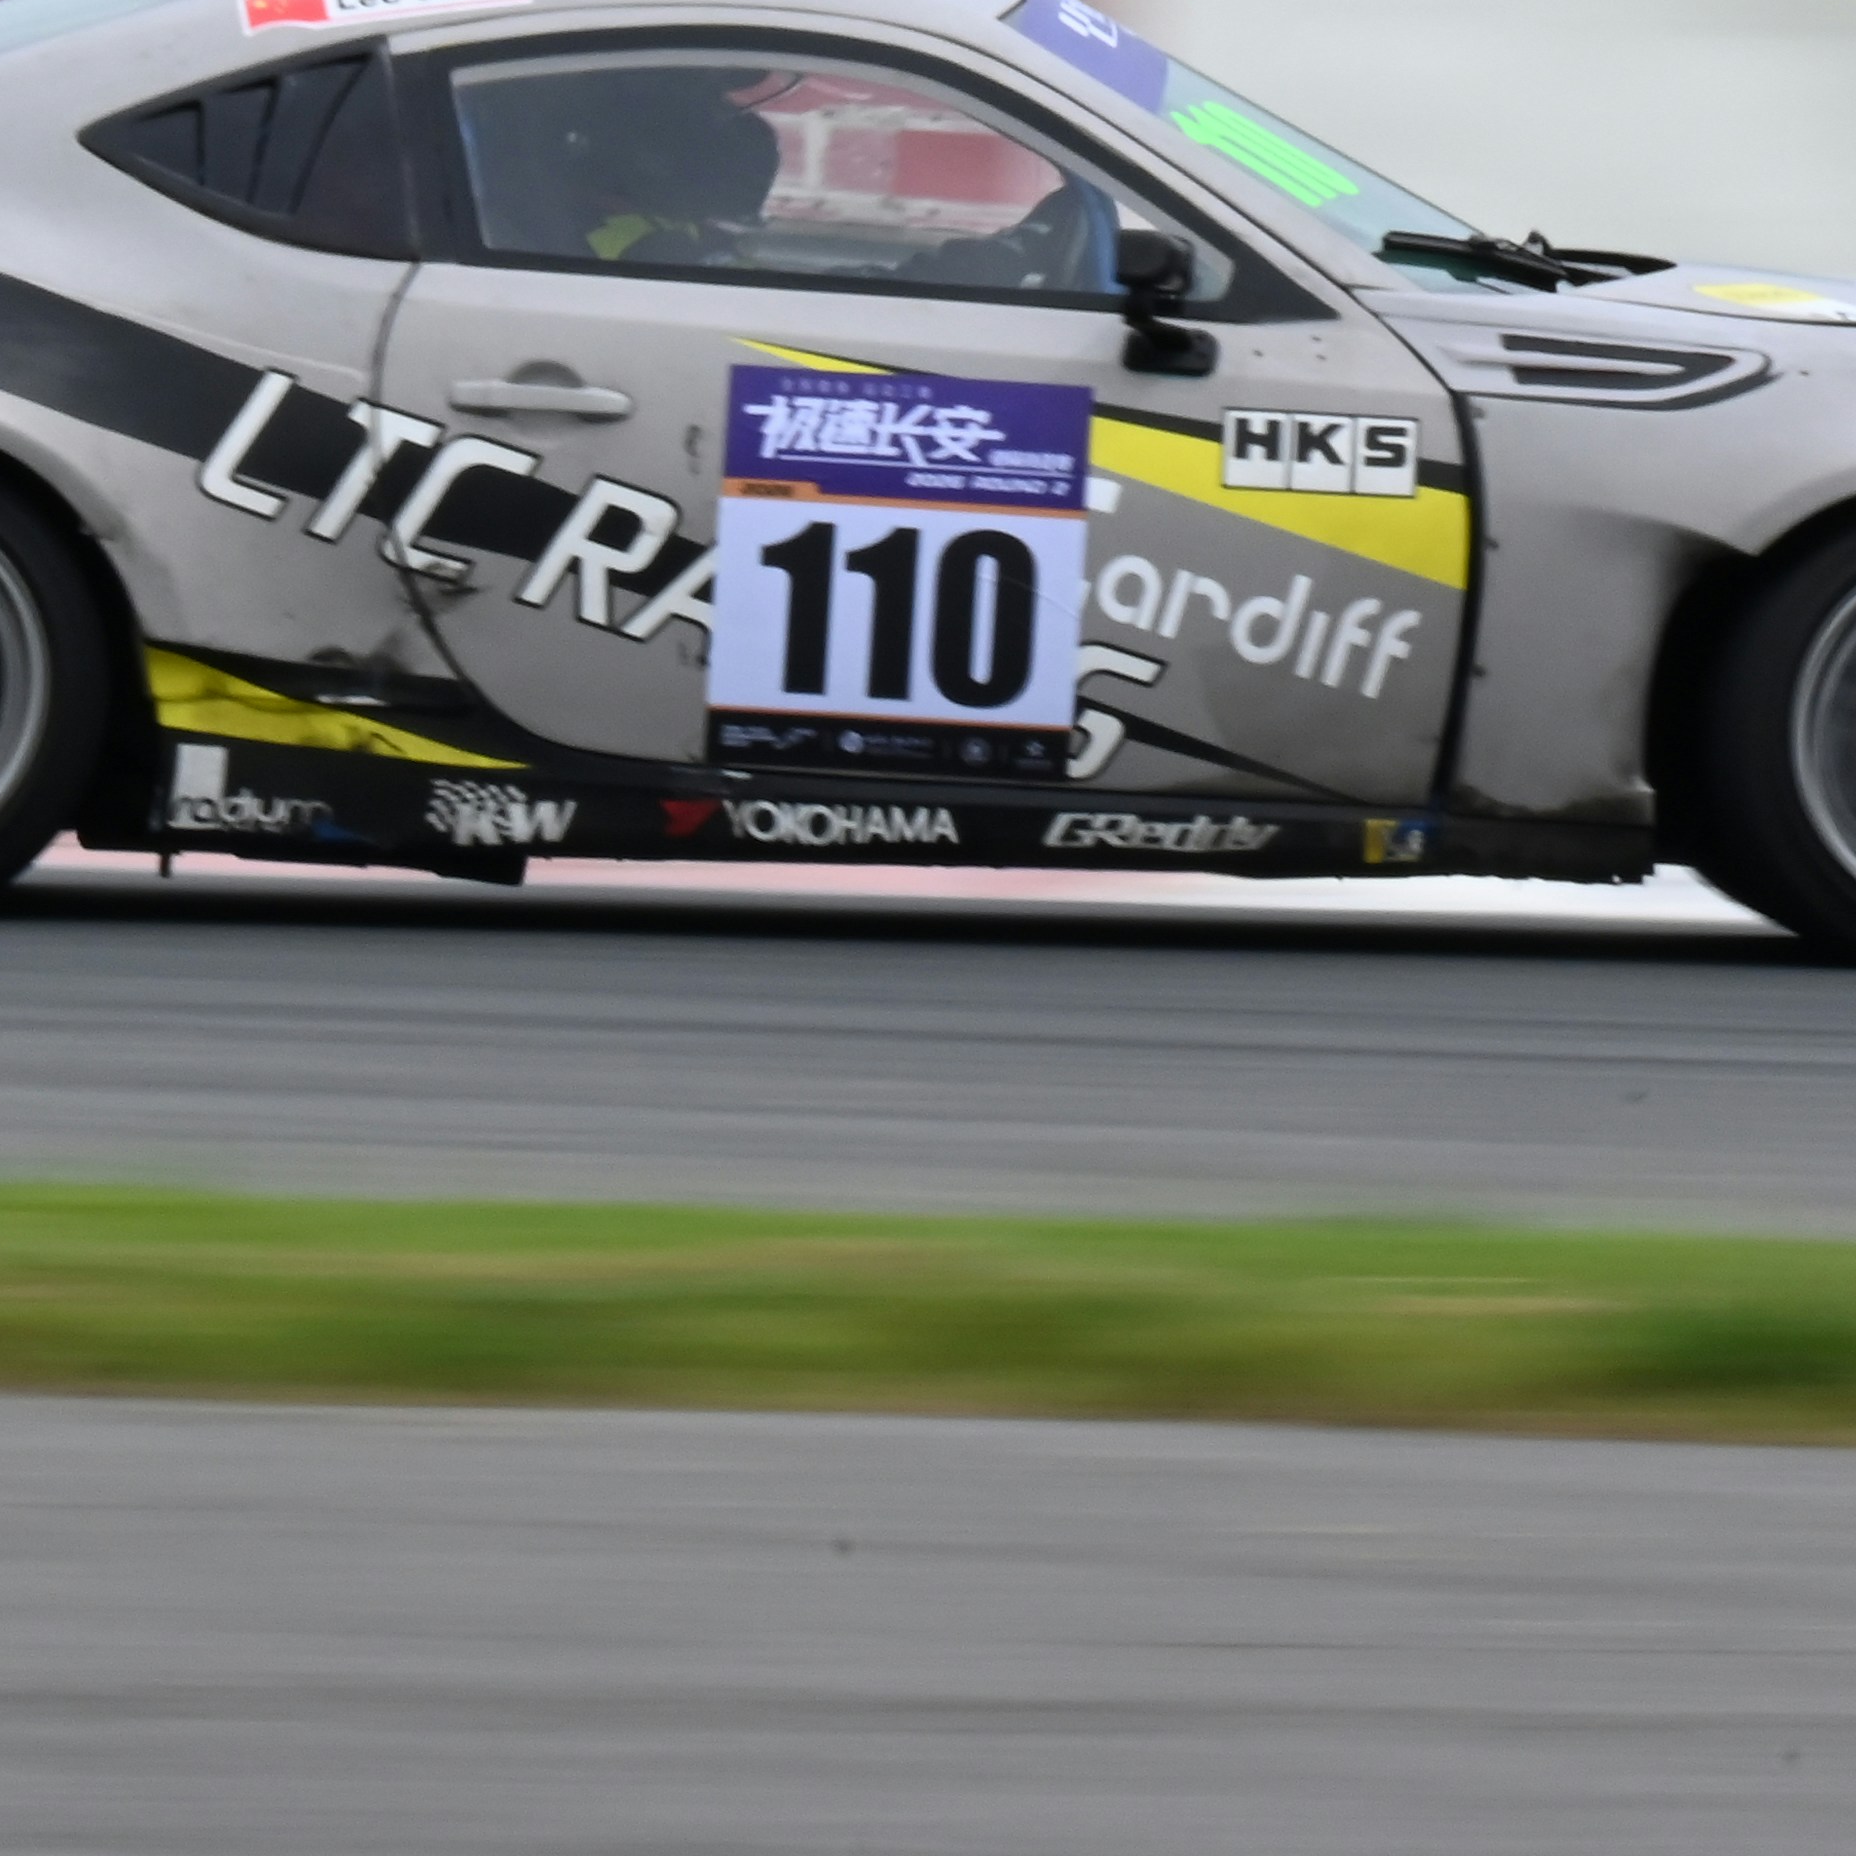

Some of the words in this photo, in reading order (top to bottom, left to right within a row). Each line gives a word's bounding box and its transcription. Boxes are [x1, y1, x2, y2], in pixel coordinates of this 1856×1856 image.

[200, 366, 540, 584] LTC
[1235, 419, 1407, 467] HKS
[762, 522, 1035, 708] 110
[1081, 476, 1424, 700] ardiff
[721, 800, 959, 846] YOKOHAMA
[1044, 812, 1281, 852] GReddy
